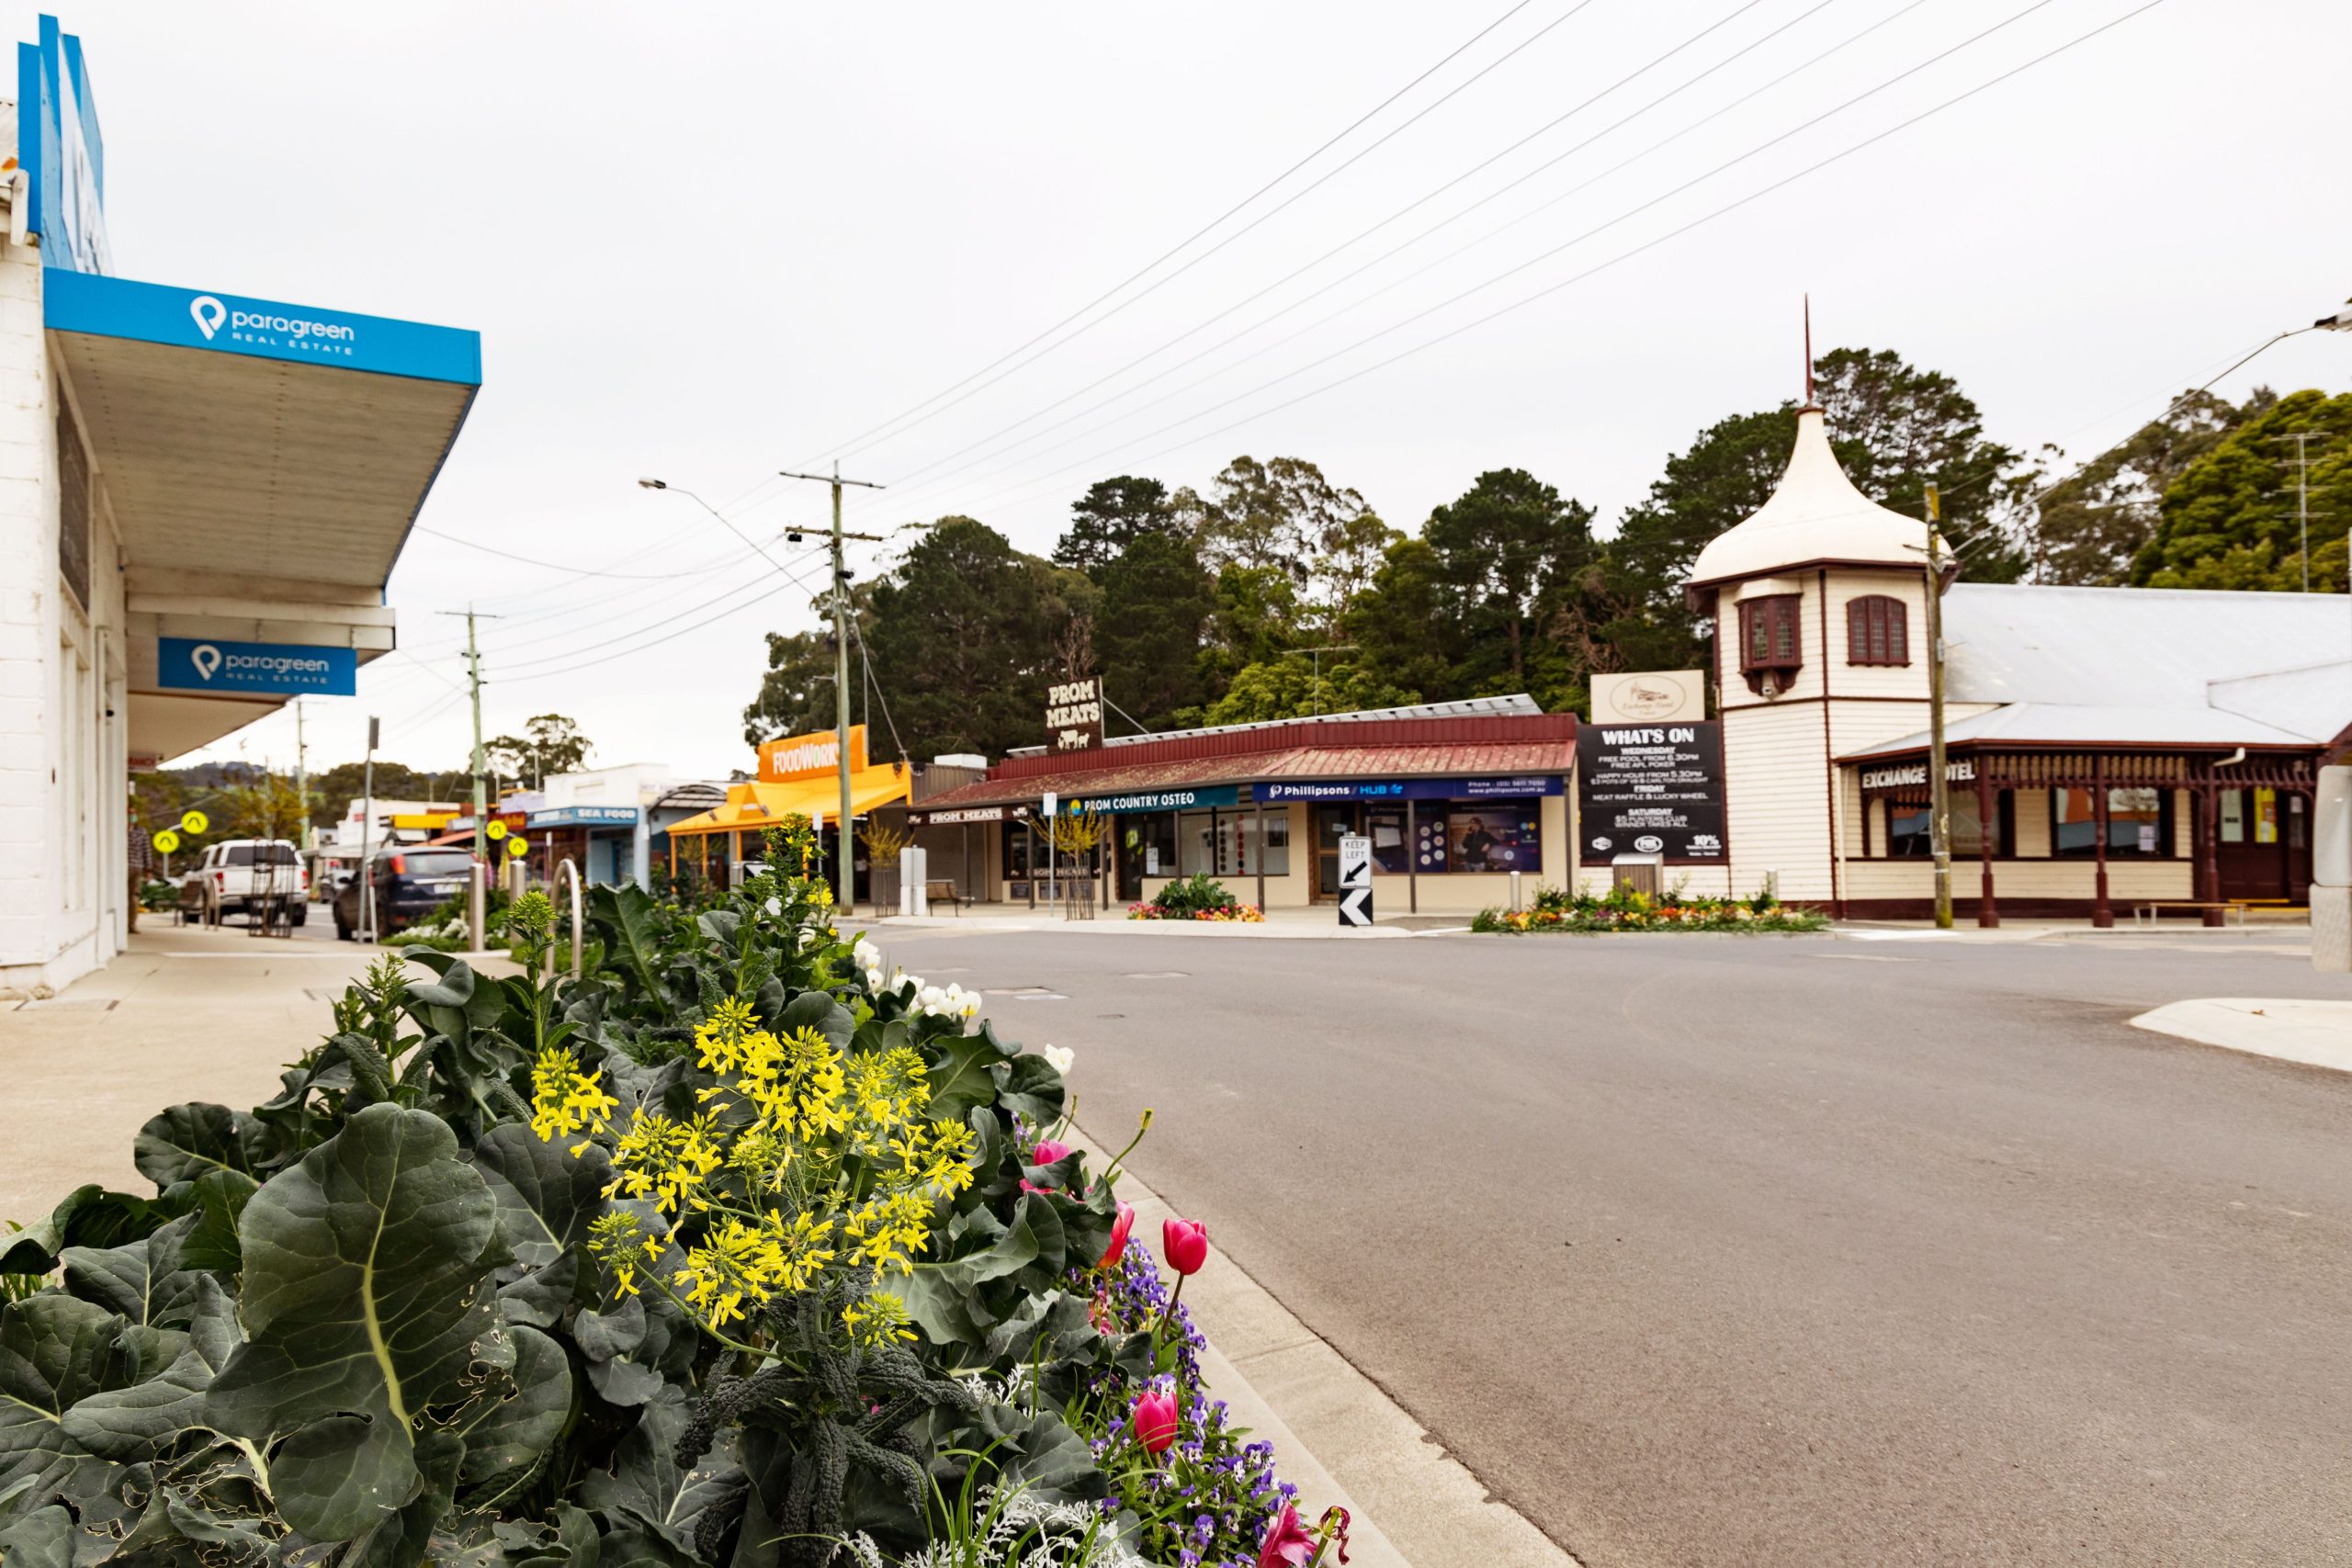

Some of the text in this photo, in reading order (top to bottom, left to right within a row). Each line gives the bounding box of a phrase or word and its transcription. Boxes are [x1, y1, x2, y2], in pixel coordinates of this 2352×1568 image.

[232, 310, 355, 341] paragreen
[232, 332, 353, 355] REAL ESTATE
[225, 654, 330, 673] paragreen
[225, 672, 328, 684] REAL ESTATE
[1048, 679, 1095, 706] PROM
[1046, 701, 1101, 728] MEATS
[1601, 728, 1695, 745] WHAT'S ON
[774, 742, 841, 774] FOODWORK
[1620, 746, 1677, 755] WEDNESDAY
[1862, 762, 1976, 788] EXCHANGE OTEL
[1283, 785, 1387, 796] Phillipsons HUB
[1614, 793, 1645, 801] RAFFLE
[1634, 784, 1666, 793] FRIDAY
[1084, 792, 1195, 811] PROM COUNTRY OSTEO
[577, 807, 637, 819] SEA FOOD
[929, 807, 1003, 825] PROM MEATS
[1345, 840, 1365, 849] KEEP
[1345, 851, 1364, 859] LEFT
